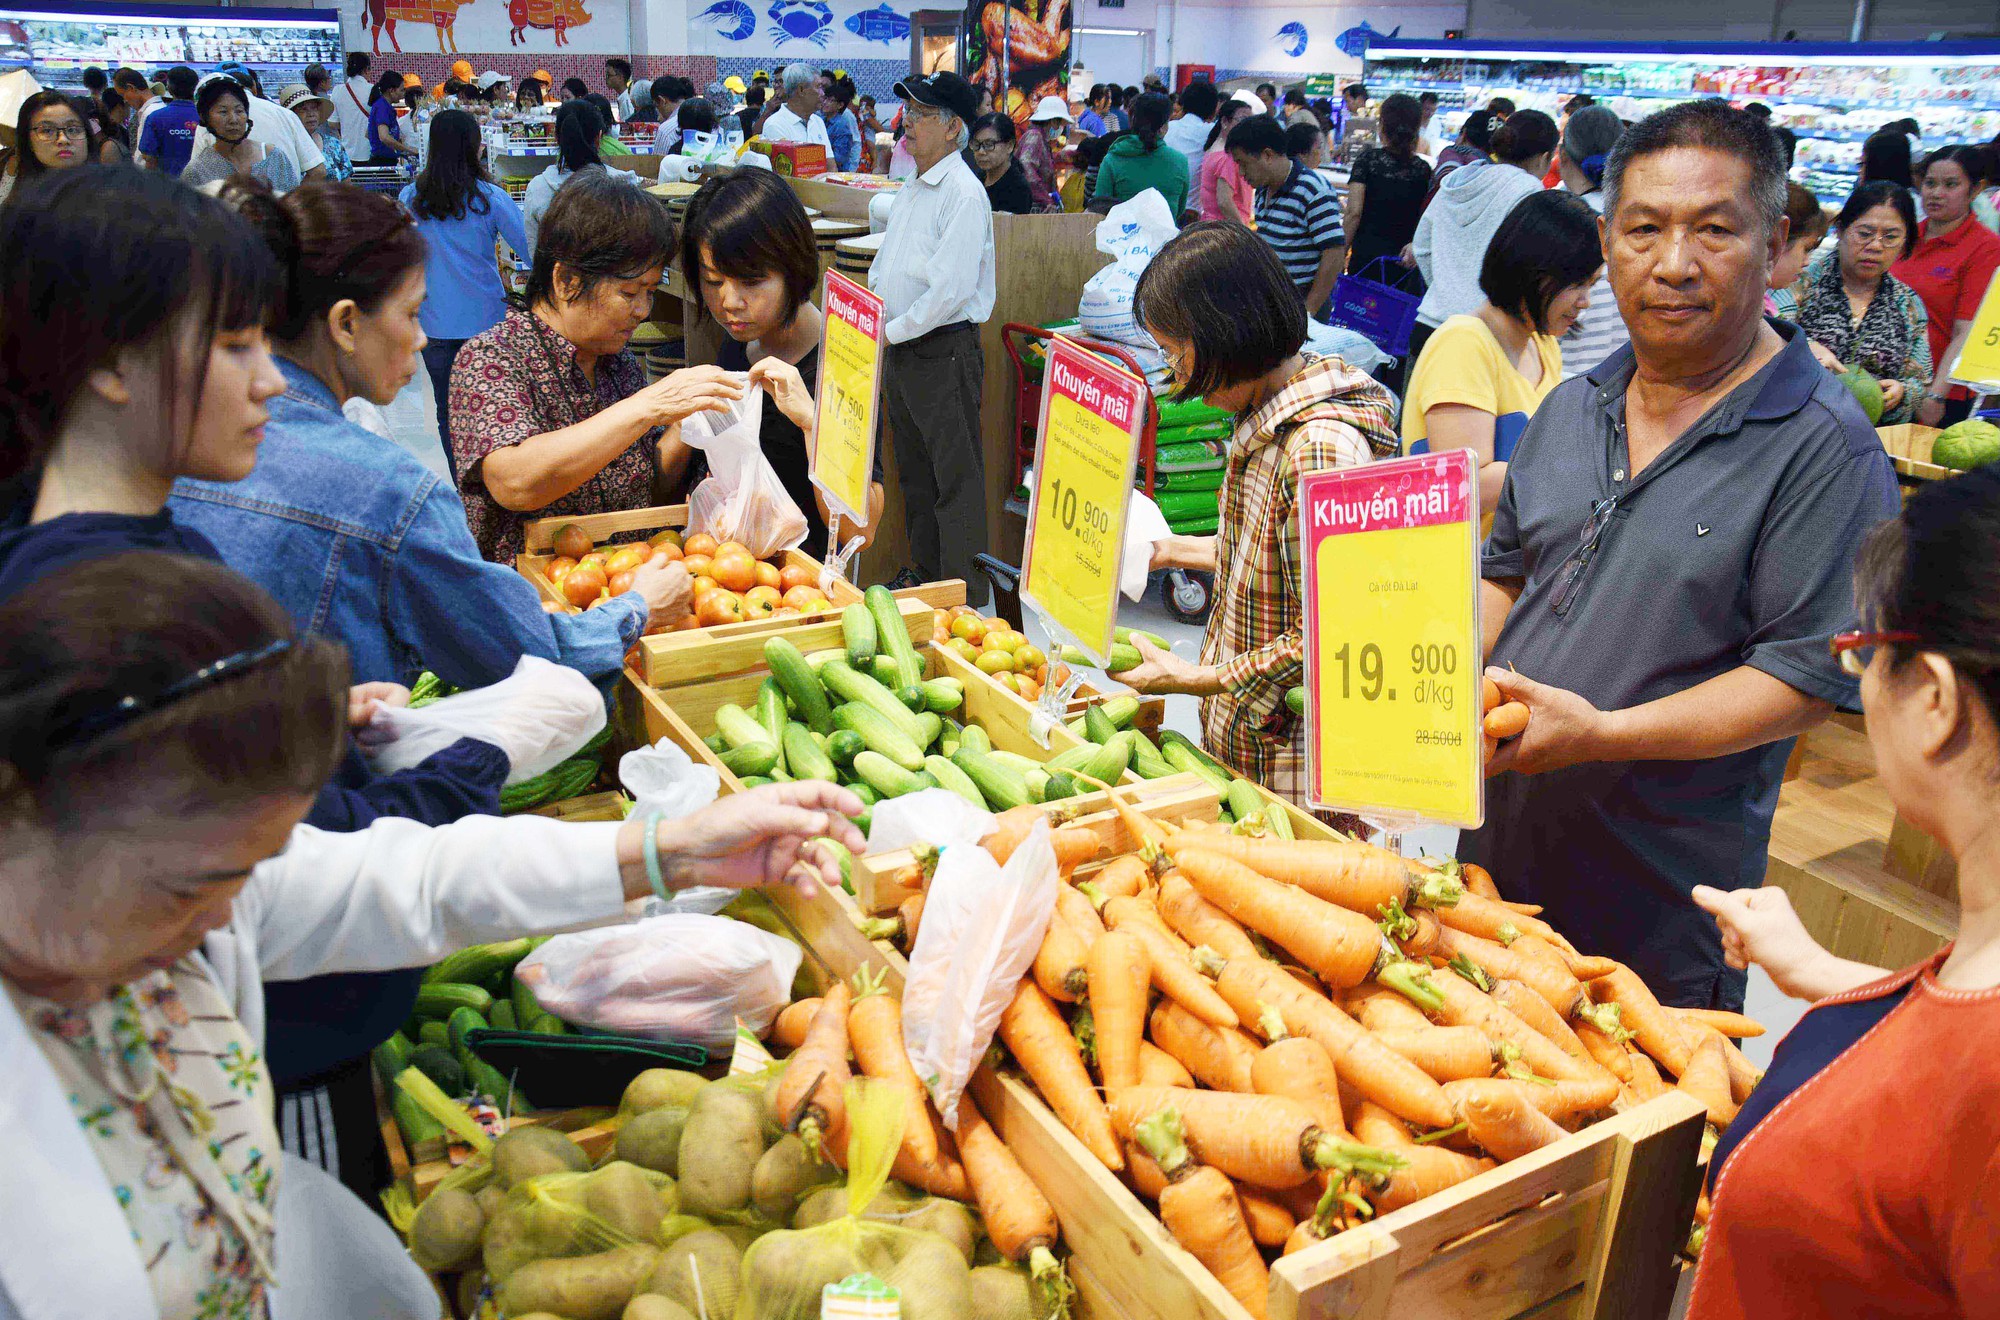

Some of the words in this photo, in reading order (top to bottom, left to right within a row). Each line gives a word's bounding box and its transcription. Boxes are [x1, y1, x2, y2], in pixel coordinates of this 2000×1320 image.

[828, 290, 857, 323] Khuyến
[859, 313, 874, 333] mãi
[1053, 361, 1100, 406] Khuyến
[1102, 393, 1129, 422] mãi
[848, 396, 864, 421] 500
[1076, 411, 1089, 429] Dưa
[1090, 420, 1100, 435] leo
[1051, 478, 1081, 537] 10.
[1083, 500, 1108, 535] 900
[1314, 486, 1398, 530] Khuyến
[1405, 481, 1449, 516] mãi
[1082, 529, 1104, 558] đ/kg
[1368, 581, 1380, 593] Cà
[1381, 579, 1391, 592] rốt
[1393, 580, 1404, 592] Đà
[1406, 580, 1418, 593] Lạt
[1334, 642, 1397, 701] 19.
[1411, 643, 1457, 674] 900
[1414, 679, 1453, 711] đ/kg
[1415, 729, 1462, 747] 28.500đ
